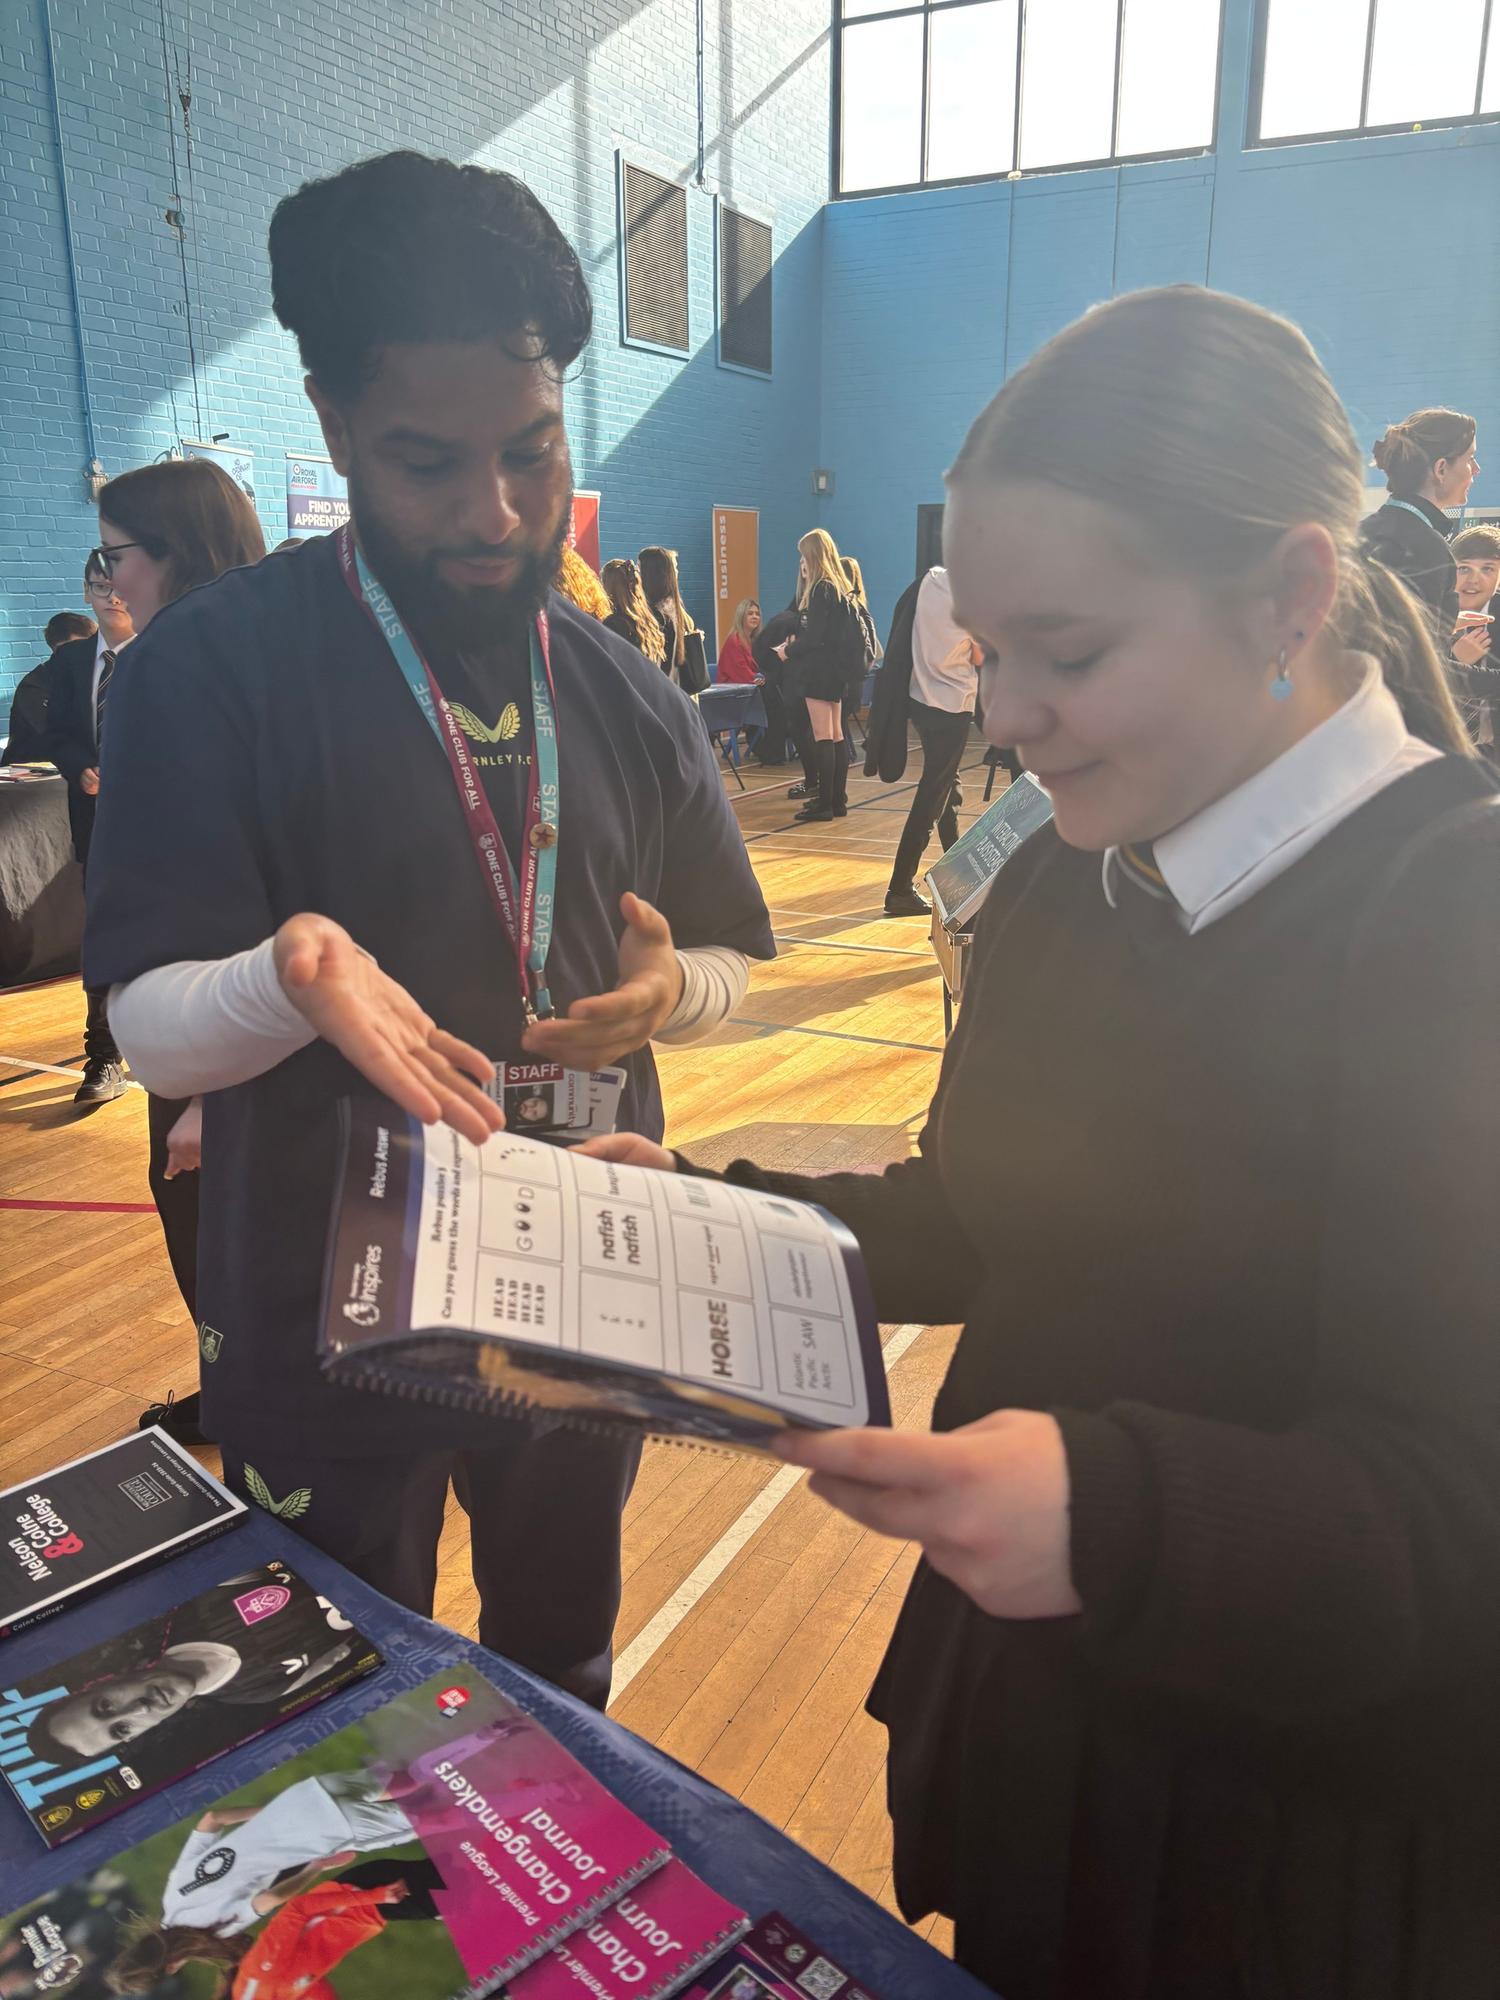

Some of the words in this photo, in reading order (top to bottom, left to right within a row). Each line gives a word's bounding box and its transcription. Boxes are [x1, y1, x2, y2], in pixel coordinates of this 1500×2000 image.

[301, 469, 317, 477] ROYAL
[301, 477, 318, 485] FORCE
[308, 500, 331, 513] FIND
[719, 515, 728, 600] Business
[363, 579, 402, 639] STAFF
[446, 714, 458, 735] ONE
[533, 681, 553, 738] STAFF
[453, 737, 467, 765] CLUB
[461, 767, 474, 788] FOR
[466, 790, 480, 810] ALL
[542, 784, 557, 825] STA
[486, 850, 500, 872] ONE
[493, 873, 507, 900] CLUB
[502, 901, 512, 921] FOR
[528, 860, 536, 880] FOR
[524, 882, 534, 908] CLUB
[522, 911, 530, 931] ONE
[535, 894, 551, 957] STAFF
[508, 1063, 559, 1080] STAFF
[567, 1073, 576, 1127] community
[369, 1157, 388, 1199] Rebus
[449, 1220, 459, 1238] the
[597, 1210, 616, 1260] nafish
[622, 1215, 640, 1265] nafish
[360, 1245, 382, 1302] Inspires
[447, 1240, 458, 1271] guess
[445, 1274, 456, 1295] you
[493, 1277, 505, 1318] HEAD
[507, 1280, 518, 1321] HEAD
[520, 1282, 532, 1323] HEAD
[533, 1285, 545, 1325] HEAD
[441, 1297, 453, 1319] Can
[800, 1318, 816, 1349] SAW
[129, 1479, 160, 1505] COLLEGE
[16, 1513, 52, 1549] Colne
[26, 1494, 69, 1536] College
[8, 1537, 52, 1581] Nelson
[434, 1761, 571, 1904] Changemakers
[520, 1807, 606, 1880] Journal
[460, 1841, 501, 1885] League
[495, 1882, 540, 1926] Premier
[21, 1924, 48, 1968] Premier
[37, 1915, 67, 1961] League
